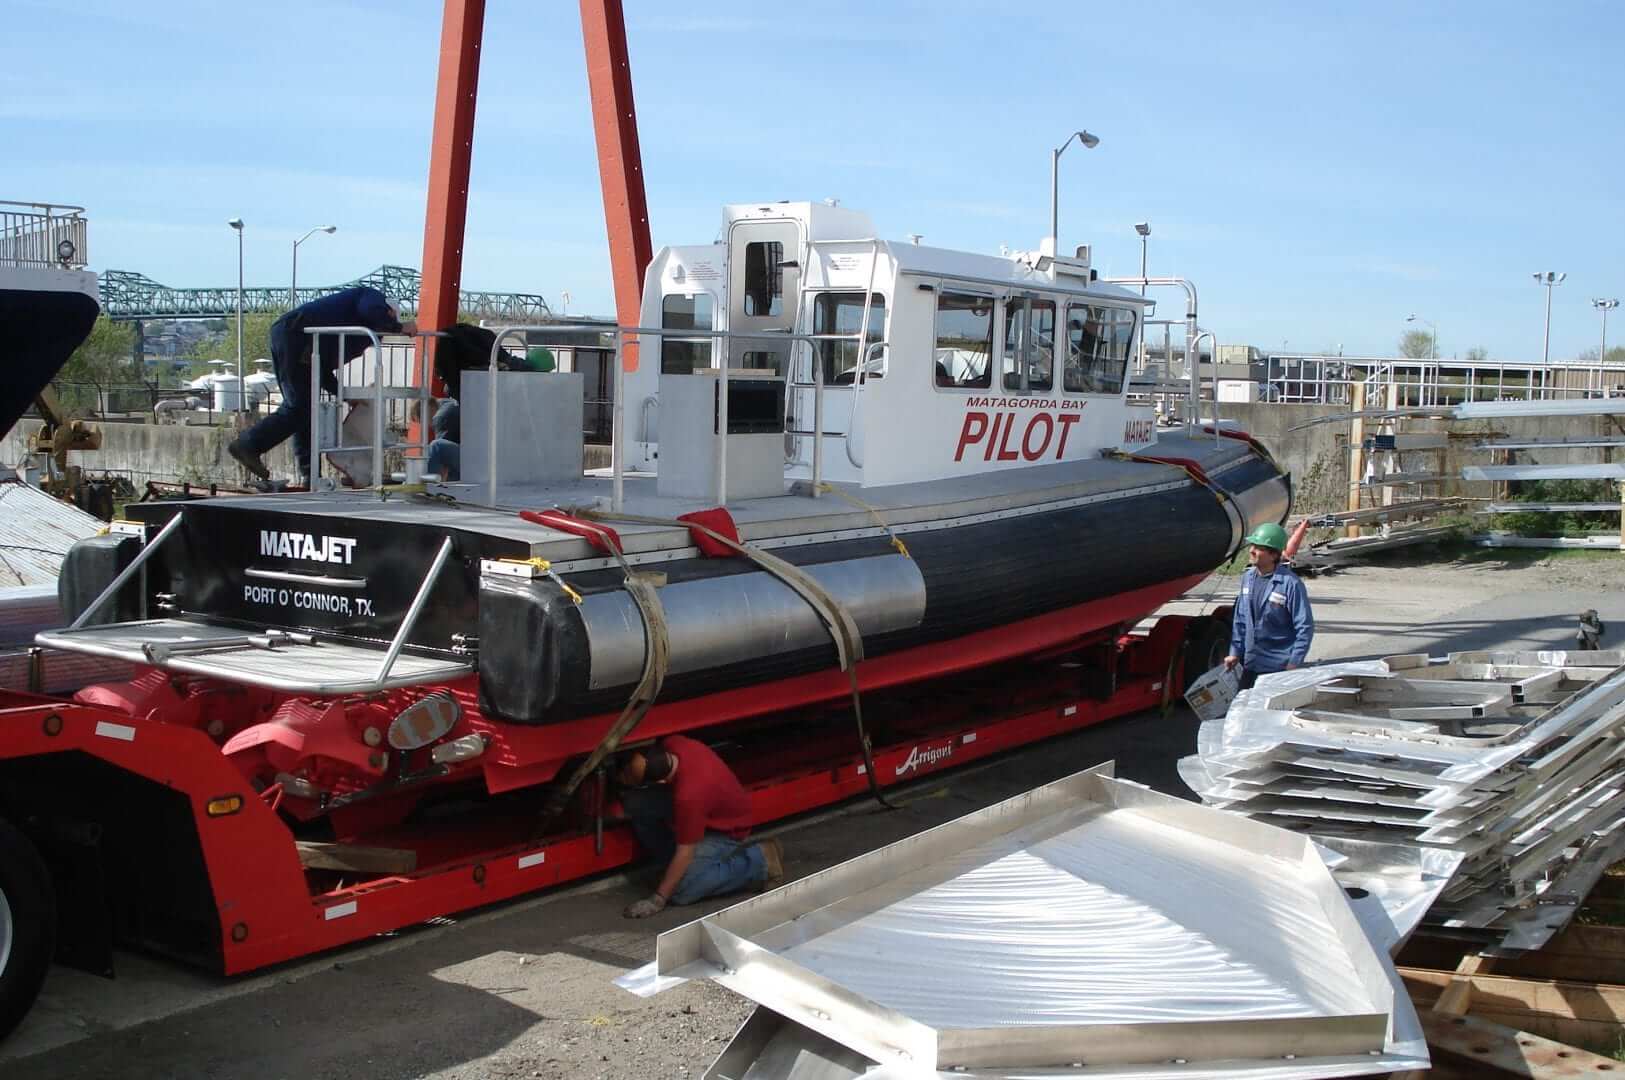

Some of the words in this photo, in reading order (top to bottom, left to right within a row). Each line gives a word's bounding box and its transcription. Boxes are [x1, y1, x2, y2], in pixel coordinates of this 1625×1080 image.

[966, 397, 1057, 409] MATAGORDA
[1061, 400, 1087, 410] BAY
[954, 412, 1081, 462] PILOT
[1124, 420, 1154, 444] MATAJET
[260, 530, 357, 564] MATAJET
[244, 585, 276, 604] PORT
[355, 598, 376, 617] TX.
[895, 741, 952, 775] Arrigoni
